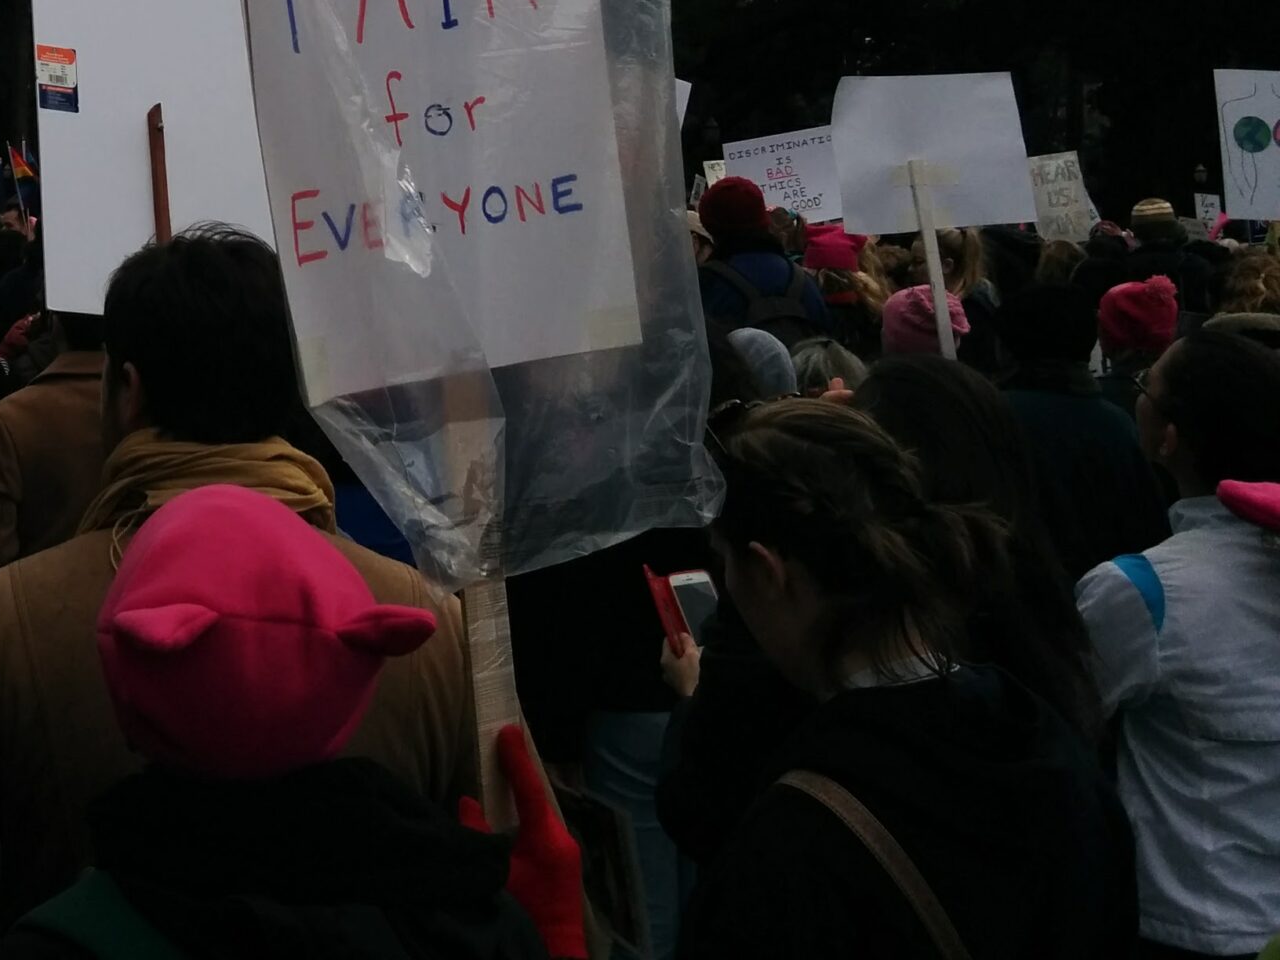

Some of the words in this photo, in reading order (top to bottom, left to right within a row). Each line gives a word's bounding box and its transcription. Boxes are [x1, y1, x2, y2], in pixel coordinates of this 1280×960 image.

[385, 70, 486, 147] for
[775, 155, 792, 166] IS
[766, 165, 794, 180] BAD
[783, 187, 807, 202] ARE
